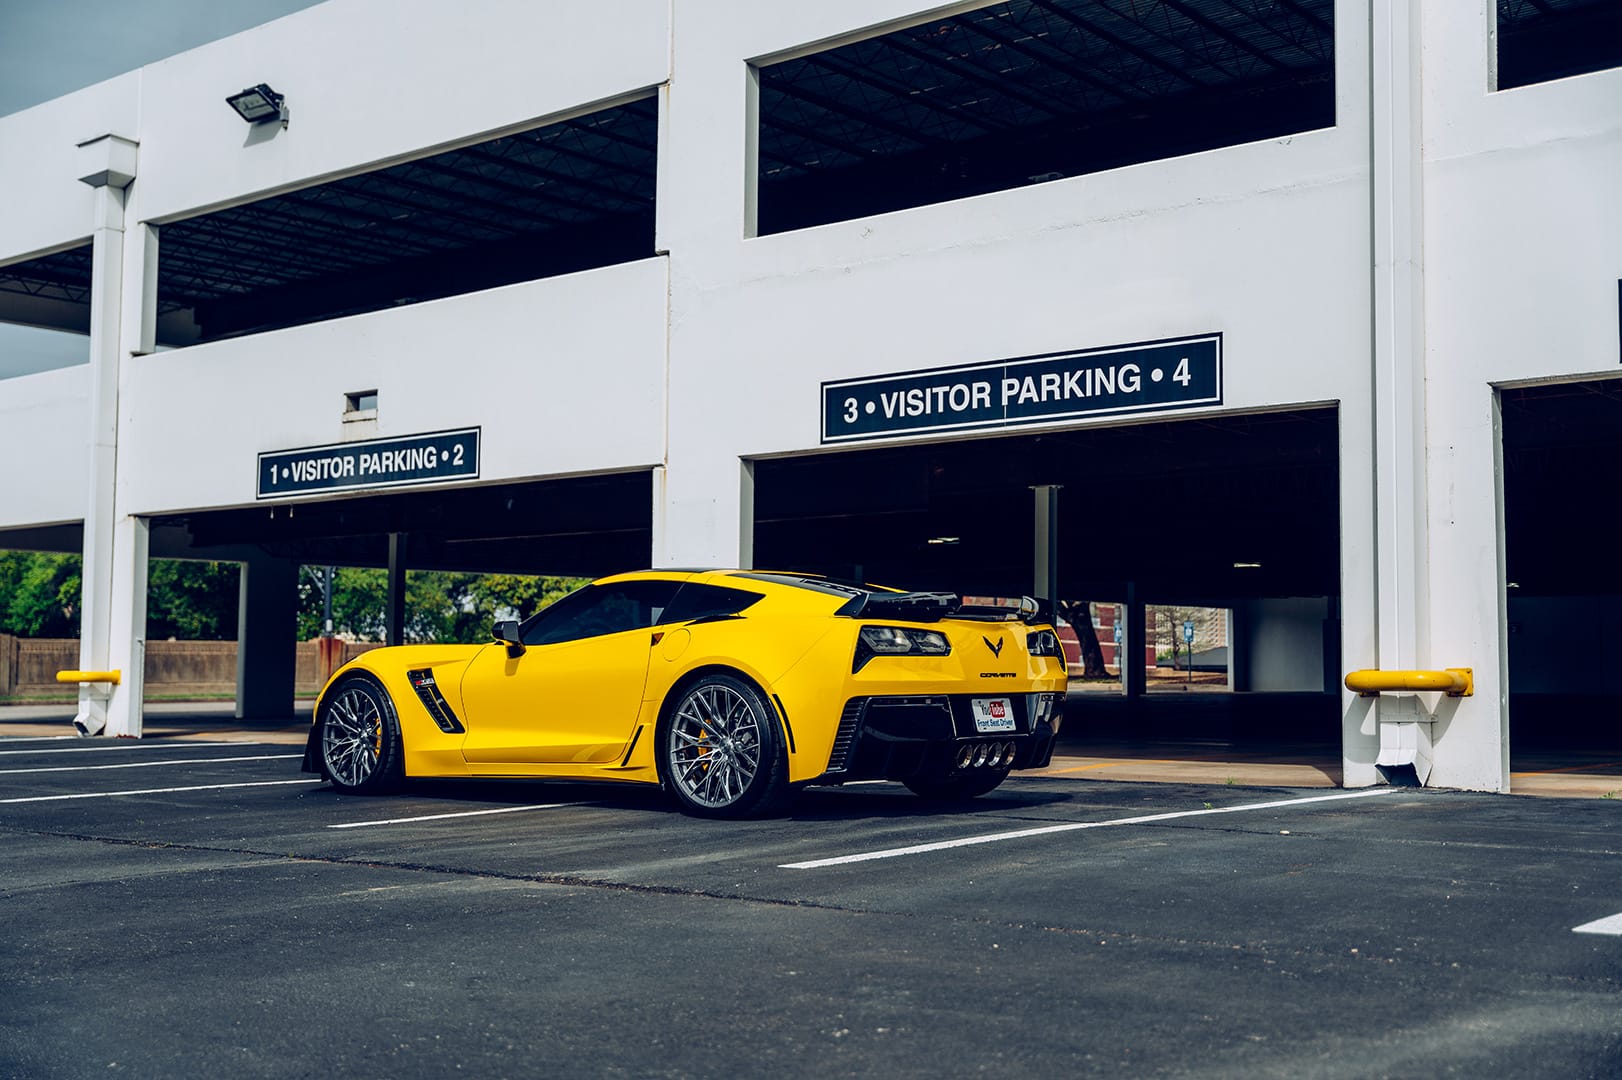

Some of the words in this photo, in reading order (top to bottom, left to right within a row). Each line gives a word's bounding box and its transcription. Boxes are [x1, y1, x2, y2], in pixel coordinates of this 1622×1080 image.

[843, 397, 858, 423] 3
[880, 381, 991, 418] VISITOR
[1001, 363, 1141, 406] PARKING
[1172, 358, 1191, 386] 4
[270, 465, 278, 484] 1
[291, 456, 354, 482] VISITOR
[359, 446, 437, 475] PARKING
[453, 444, 464, 466] 2
